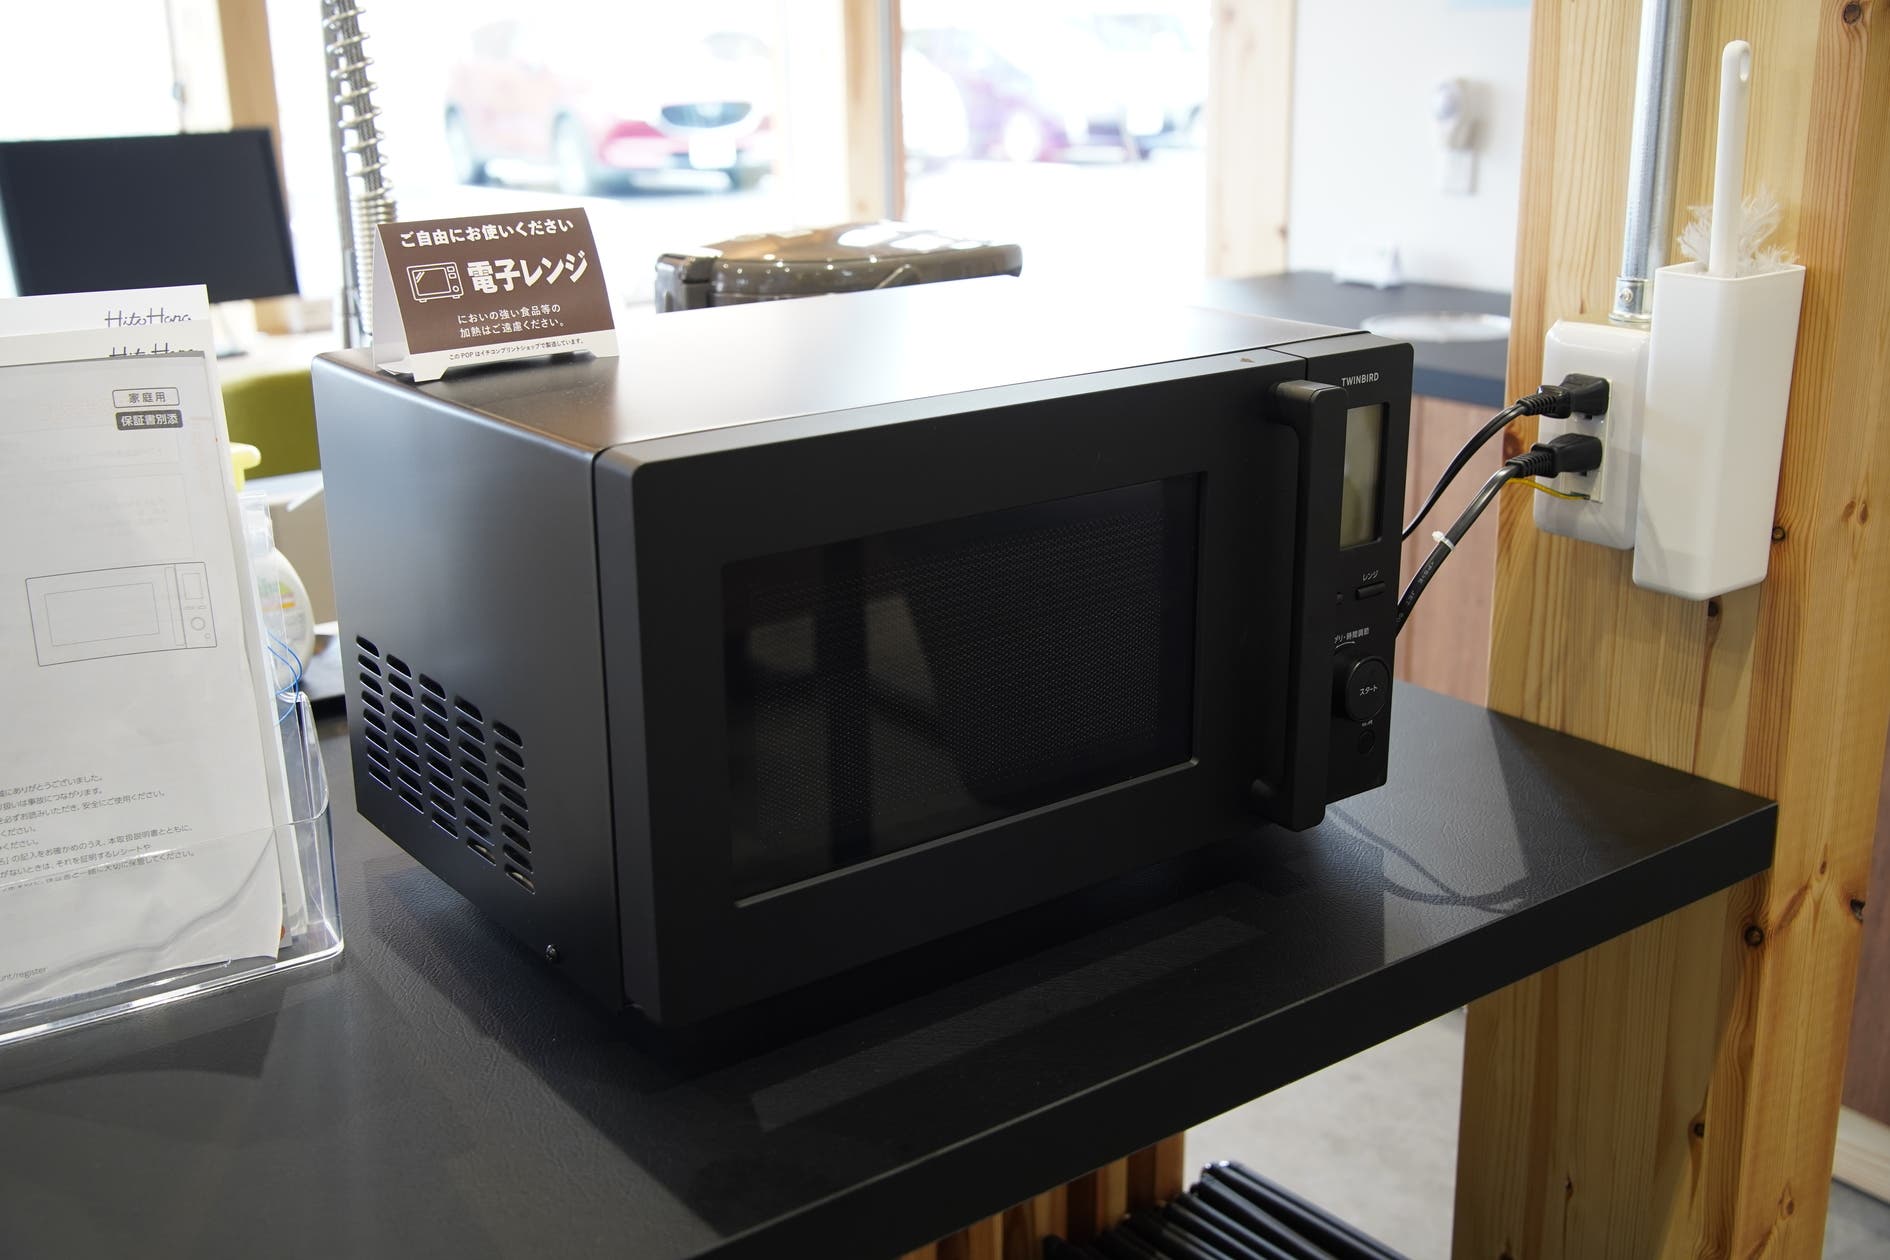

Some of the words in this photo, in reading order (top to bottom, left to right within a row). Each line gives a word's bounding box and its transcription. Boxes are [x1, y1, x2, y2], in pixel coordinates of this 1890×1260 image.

[400, 218, 574, 248] ご自由にお使いください
[467, 250, 588, 294] 電子レンジ
[457, 304, 561, 324] においの強い食品等の
[459, 318, 565, 338] 加熱はご遠慮ください。
[1341, 372, 1379, 387] TWINBIRD
[128, 391, 166, 404] 家庭用
[121, 413, 179, 427] 保証書別添
[1362, 569, 1379, 582] レンジ
[1359, 685, 1378, 696] スタート
[0, 839, 39, 851] ください。
